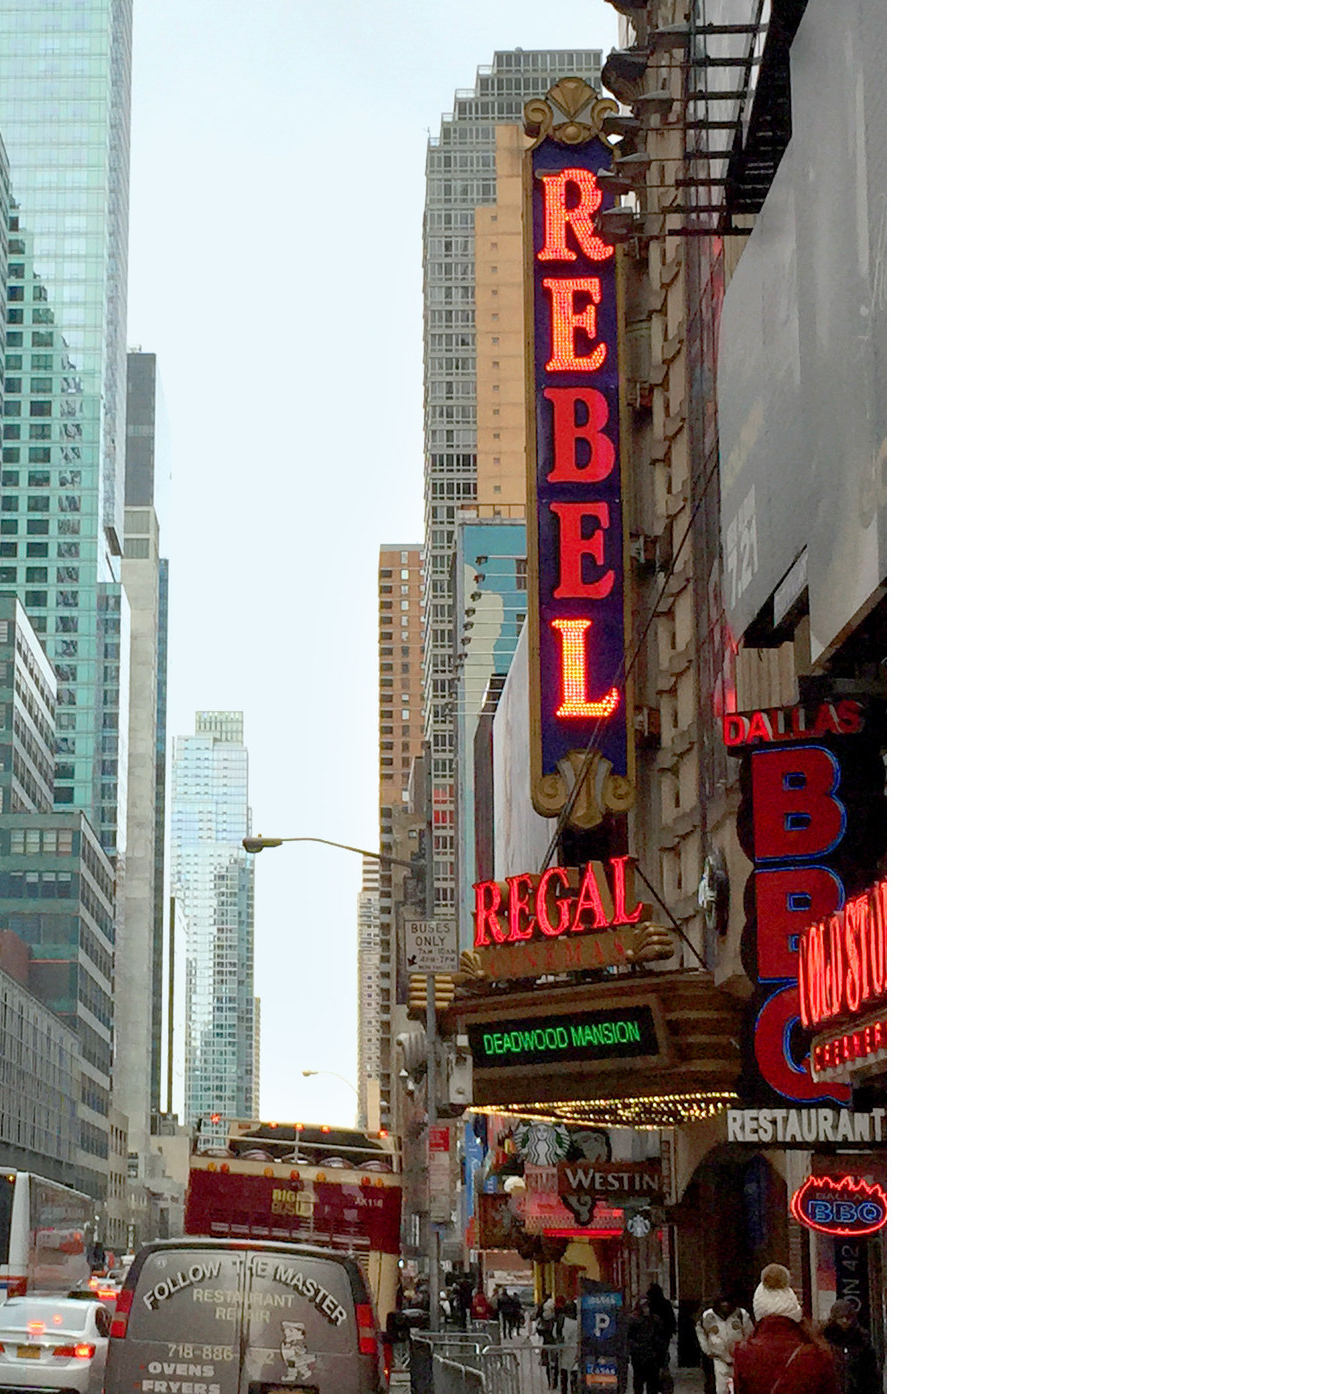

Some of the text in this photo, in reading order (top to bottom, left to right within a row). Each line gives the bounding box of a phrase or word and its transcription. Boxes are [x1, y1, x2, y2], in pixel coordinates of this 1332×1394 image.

[537, 168, 621, 718] REBEL
[723, 699, 864, 747] DALLAS
[472, 855, 644, 948] REGAL
[411, 923, 451, 934] BUSES
[752, 745, 851, 1106] BBQ
[415, 936, 446, 947] ONLY
[483, 1020, 641, 1055] DEADWOOD MANSION
[727, 1108, 886, 1143] RESTAURANT
[565, 1167, 659, 1191] WESTIN
[808, 1200, 883, 1224] BBQ
[841, 1245, 859, 1272] 42
[143, 1259, 348, 1327] FOLLOW THE MASTER
[193, 1288, 295, 1308] RESTAURANT
[215, 1307, 270, 1323] REAIR
[594, 1313, 611, 1337] P
[148, 1362, 215, 1377] OVENS
[142, 1380, 221, 1394] FRYERS
